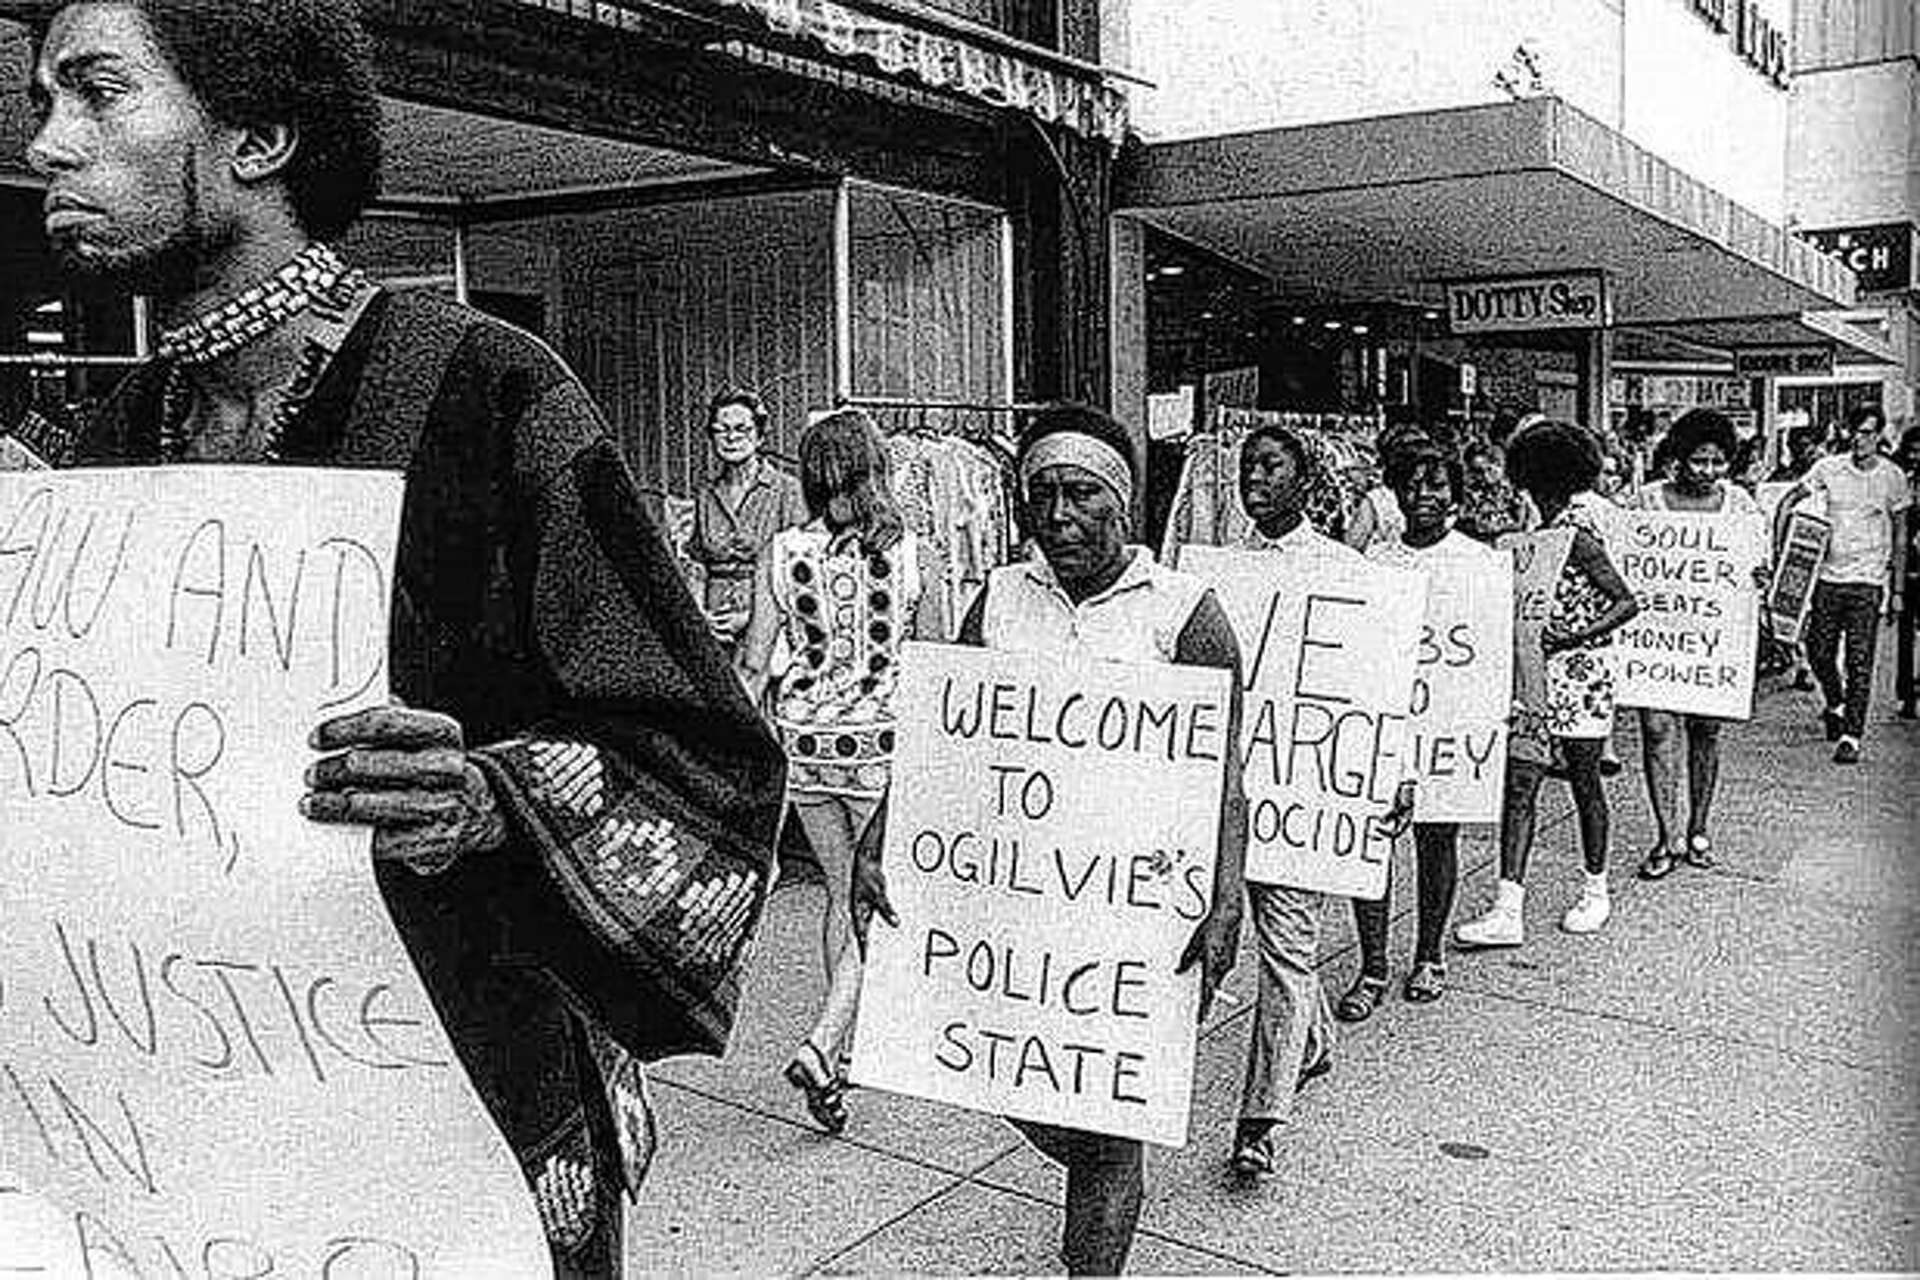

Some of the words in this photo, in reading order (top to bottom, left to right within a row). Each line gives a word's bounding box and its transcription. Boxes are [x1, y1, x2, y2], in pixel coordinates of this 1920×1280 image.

[1454, 285, 1546, 321] DOTTY
[1623, 554, 1738, 588] POWER
[1632, 524, 1729, 552] SOUL
[166, 519, 387, 710] AND
[1617, 627, 1722, 657] MONEY
[1625, 659, 1738, 689] POWER
[941, 677, 1221, 763] WELCOME
[990, 764, 1055, 820] TO
[1252, 799, 1386, 865] OCIDE
[43, 921, 450, 1083] JUSTICE
[923, 928, 1150, 1019] POLICE
[935, 1022, 1148, 1105] STATE
[3, 1063, 157, 1195] IN
